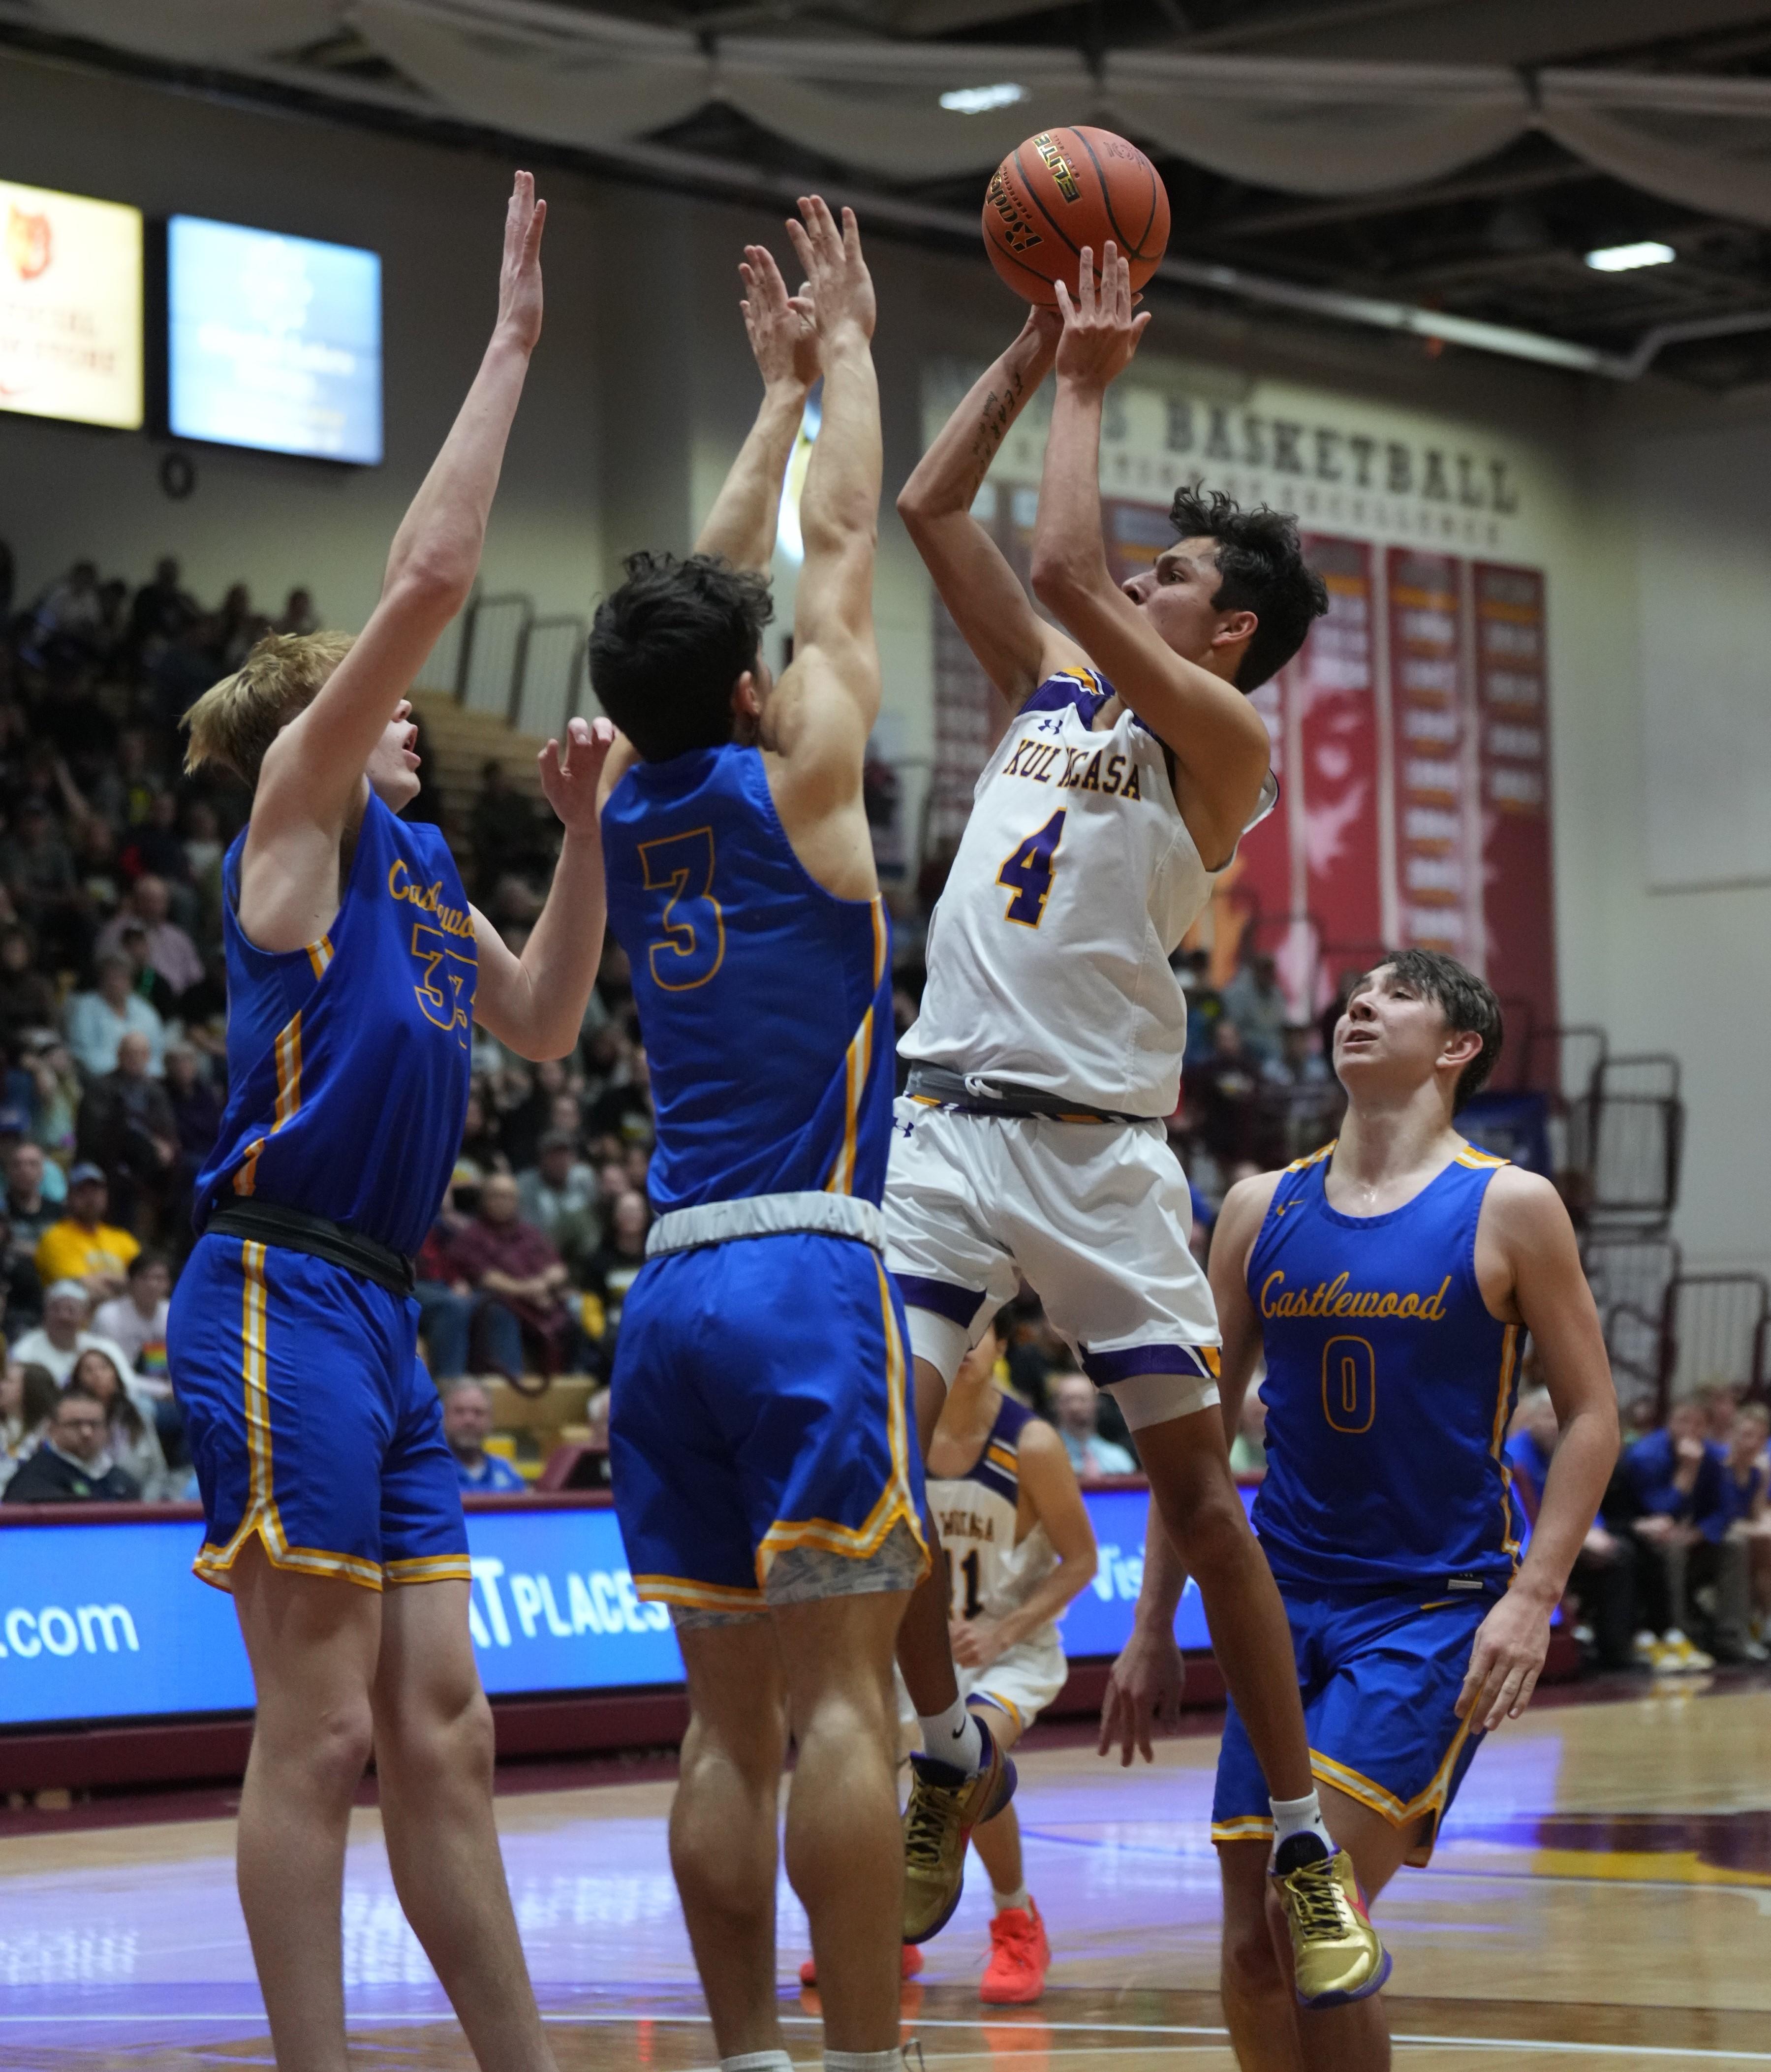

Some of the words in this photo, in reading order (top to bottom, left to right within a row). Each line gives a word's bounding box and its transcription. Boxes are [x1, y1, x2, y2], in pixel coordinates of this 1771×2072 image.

[1033, 133, 1083, 204] ELITE
[1165, 397, 1518, 515] BASKETBALL
[1002, 738, 1061, 783] KUL
[638, 826, 726, 992] 3
[995, 806, 1067, 930] 4
[1261, 1270, 1451, 1321] Castlewood
[1322, 1335, 1375, 1434] 0
[509, 1568, 671, 1639] PLACES
